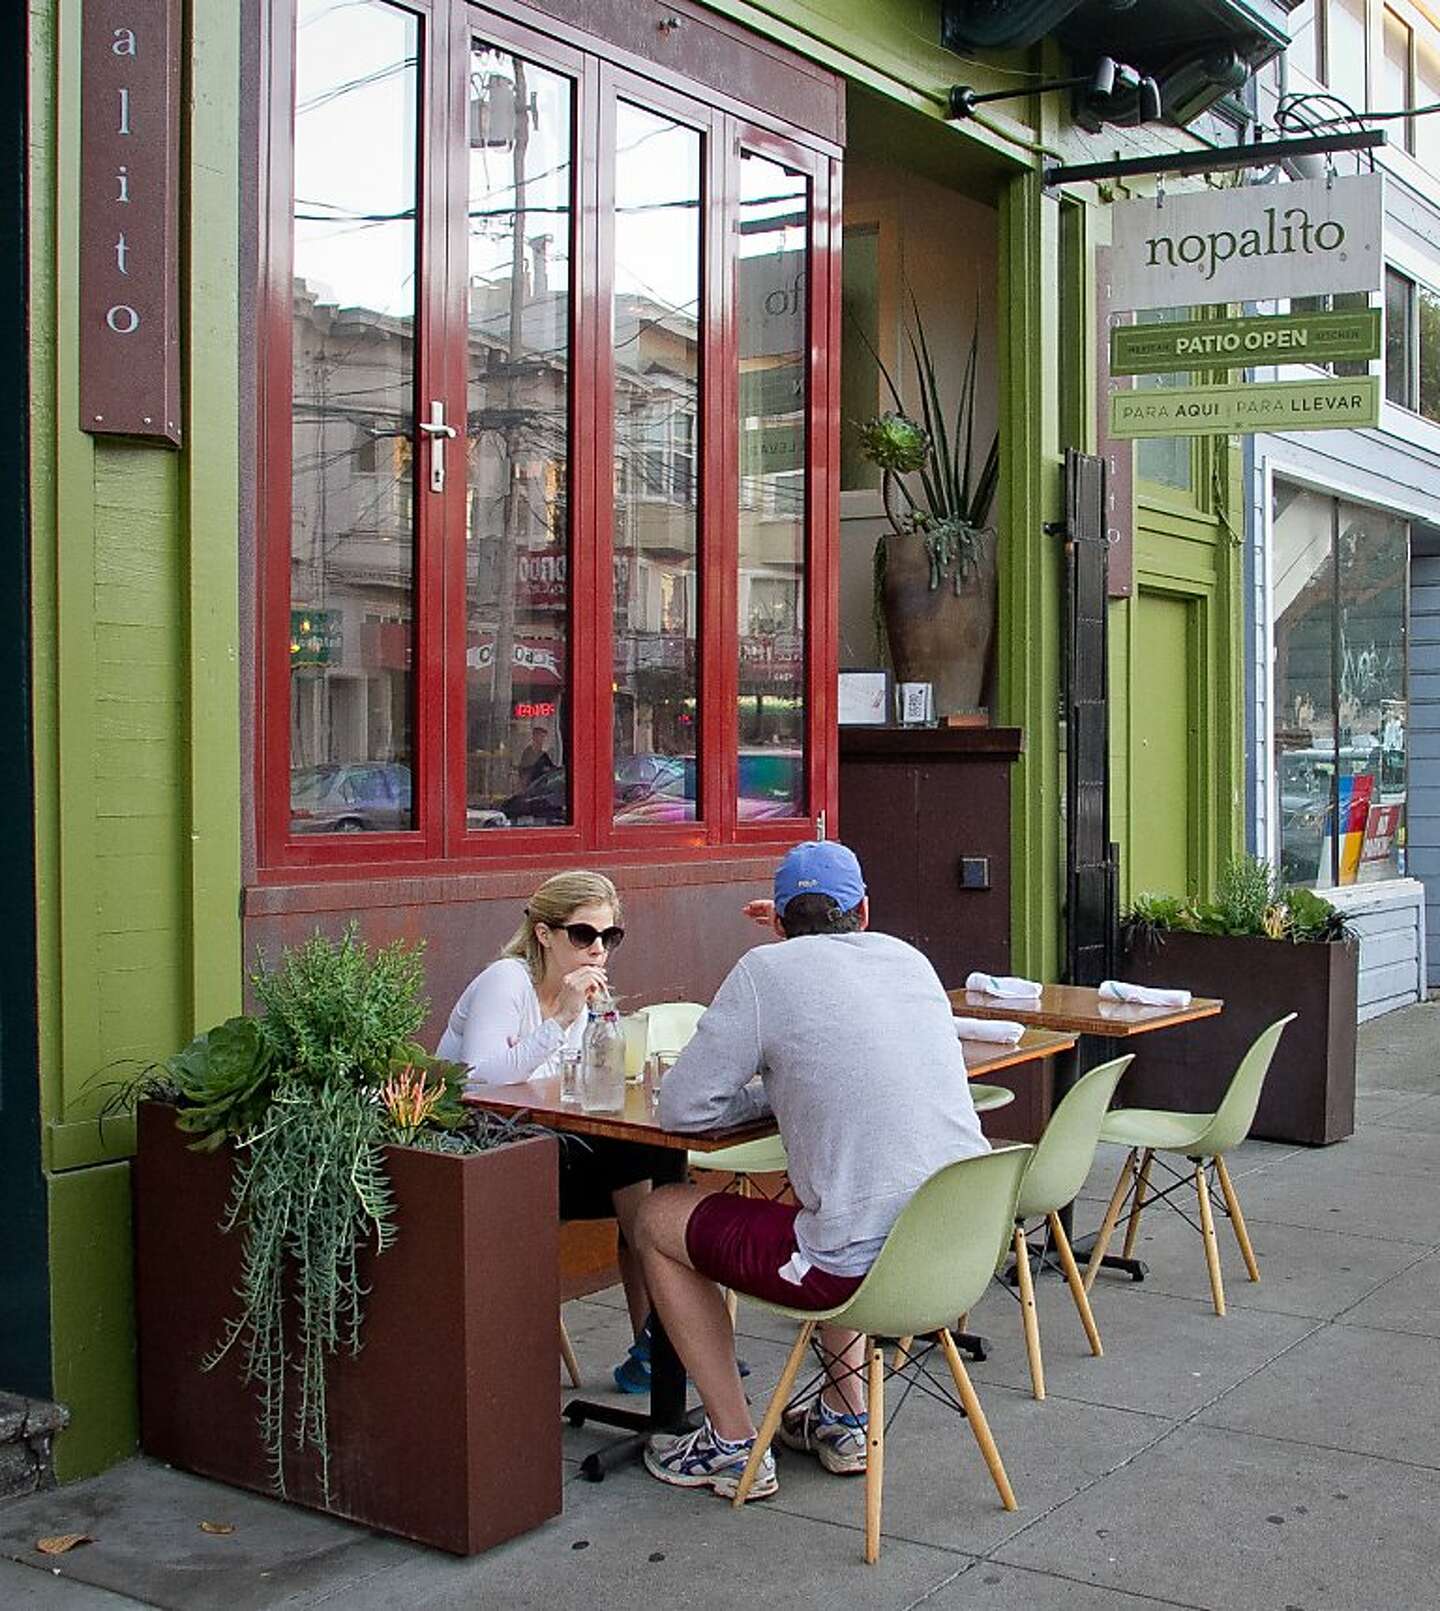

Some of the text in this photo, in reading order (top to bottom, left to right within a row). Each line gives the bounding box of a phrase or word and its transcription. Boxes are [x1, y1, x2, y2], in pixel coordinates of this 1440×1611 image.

[1145, 207, 1346, 281] nopalito
[1176, 328, 1308, 355] PATIO OPEN
[1123, 394, 1363, 420] PARA AQUI PARA LLEVAR
